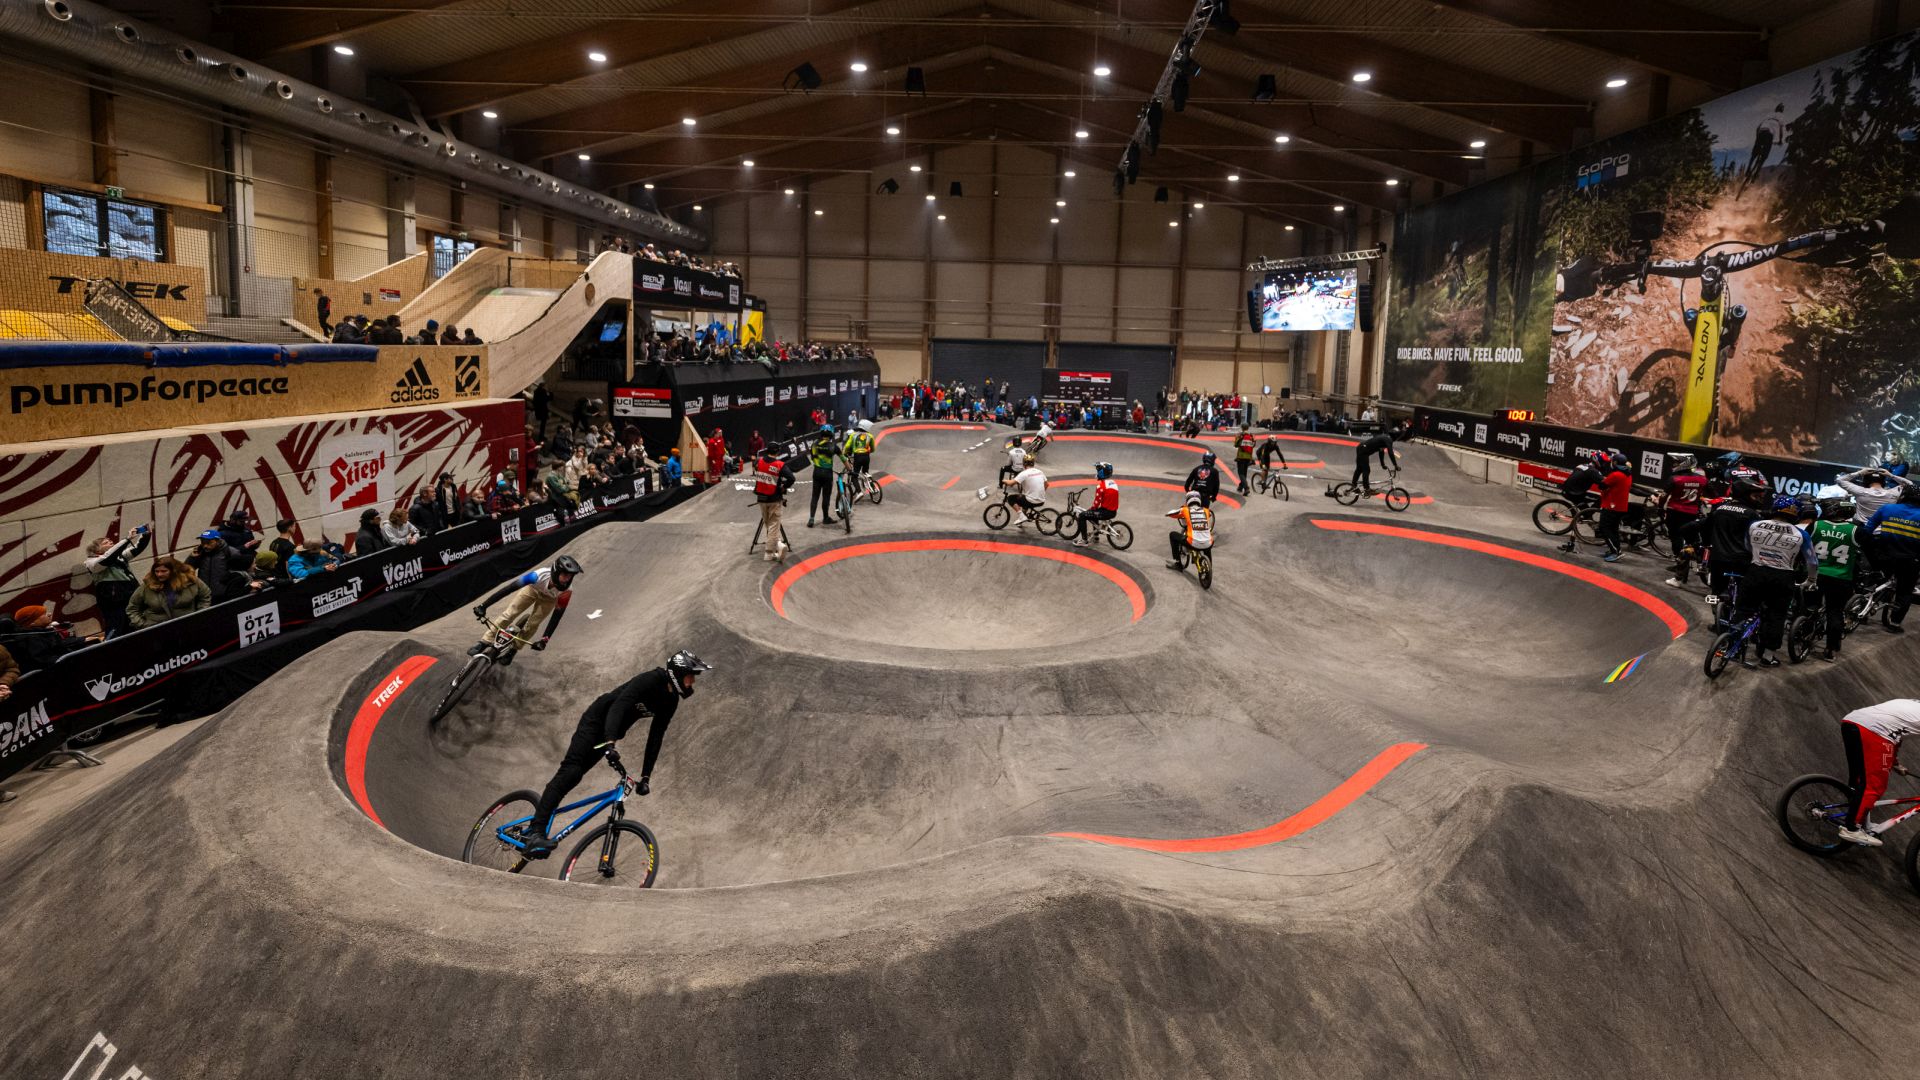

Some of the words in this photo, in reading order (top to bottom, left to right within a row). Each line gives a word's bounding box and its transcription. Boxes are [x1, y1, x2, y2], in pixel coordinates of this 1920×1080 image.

[1578, 154, 1630, 177] GoPro
[49, 276, 191, 300] TEK
[1397, 347, 1412, 360] RIDE
[1412, 347, 1433, 360] BIKES.
[1434, 347, 1453, 361] HAVE
[1454, 348, 1472, 362] FUN.
[1473, 348, 1493, 362] FEEL
[1495, 348, 1524, 363] GOOD.
[11, 377, 288, 413] pumpforpeace
[391, 386, 440, 403] adidas
[1437, 383, 1463, 392] TREK
[1497, 432, 1531, 452] AREA47
[1540, 437, 1566, 453] VGAN
[1643, 465, 1659, 475] TAL
[1644, 455, 1660, 466] ÖTZ
[329, 449, 386, 502] Stiegl
[1519, 475, 1532, 485] UCI
[1773, 476, 1825, 497] VGAN
[1820, 529, 1847, 541] SALEK
[1815, 541, 1850, 565] 44
[383, 557, 424, 585] VGAN
[312, 576, 363, 609] AREA47
[385, 573, 424, 592] CHOCOLATE
[244, 613, 275, 631] ÖTZ
[245, 628, 275, 645] TAL
[85, 649, 208, 701] Velosolutions
[372, 675, 404, 708] TREK
[1, 724, 55, 758] COLATE
